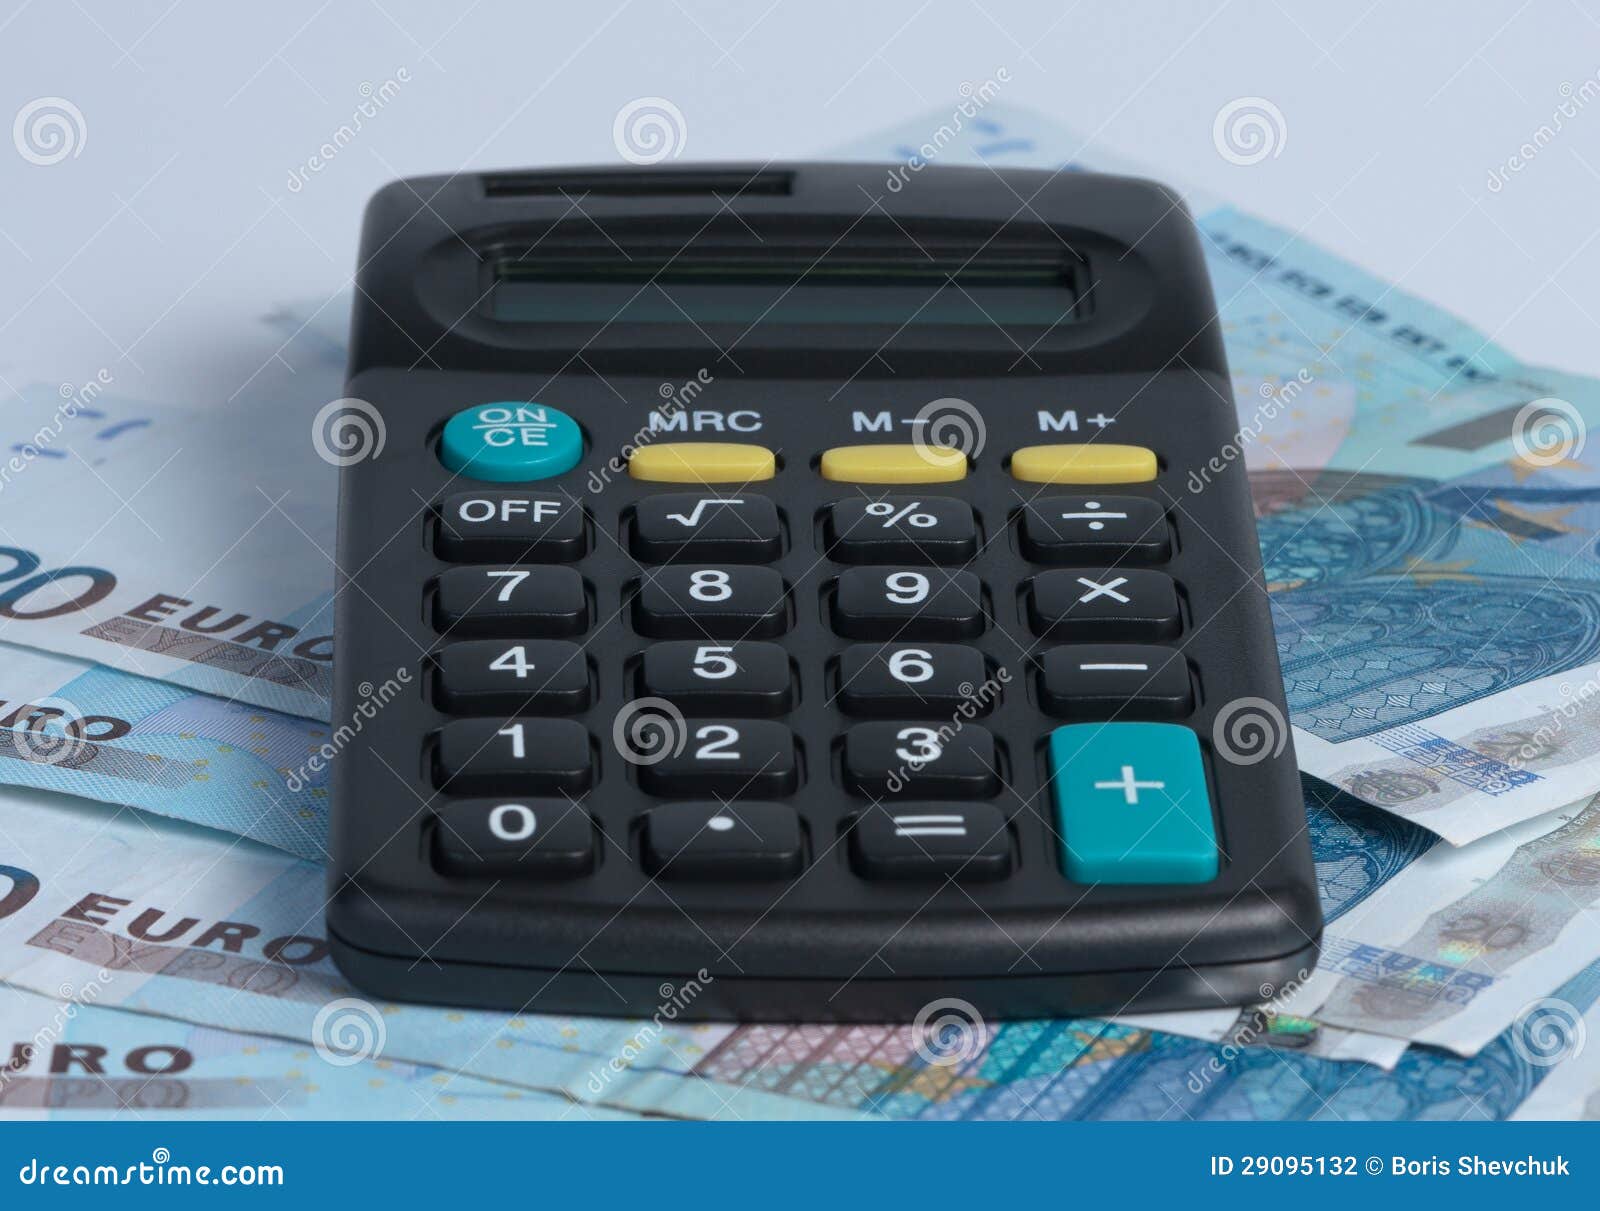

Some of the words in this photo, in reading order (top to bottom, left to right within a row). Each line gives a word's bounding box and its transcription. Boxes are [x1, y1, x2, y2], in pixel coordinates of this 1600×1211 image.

[479, 408, 545, 425] ON
[649, 410, 763, 432] MRC
[485, 429, 549, 447] CE
[459, 500, 561, 523] OFF
[866, 502, 938, 529] %
[487, 570, 531, 602] 7
[689, 569, 733, 602] 8
[886, 571, 931, 604] 9
[489, 646, 536, 678] 4
[692, 646, 738, 679] 5
[888, 649, 935, 683] 6
[498, 723, 526, 758] 1
[696, 726, 741, 760] 2
[896, 727, 943, 763] 3
[489, 804, 537, 841] 0
[62, 892, 330, 965] EURO
